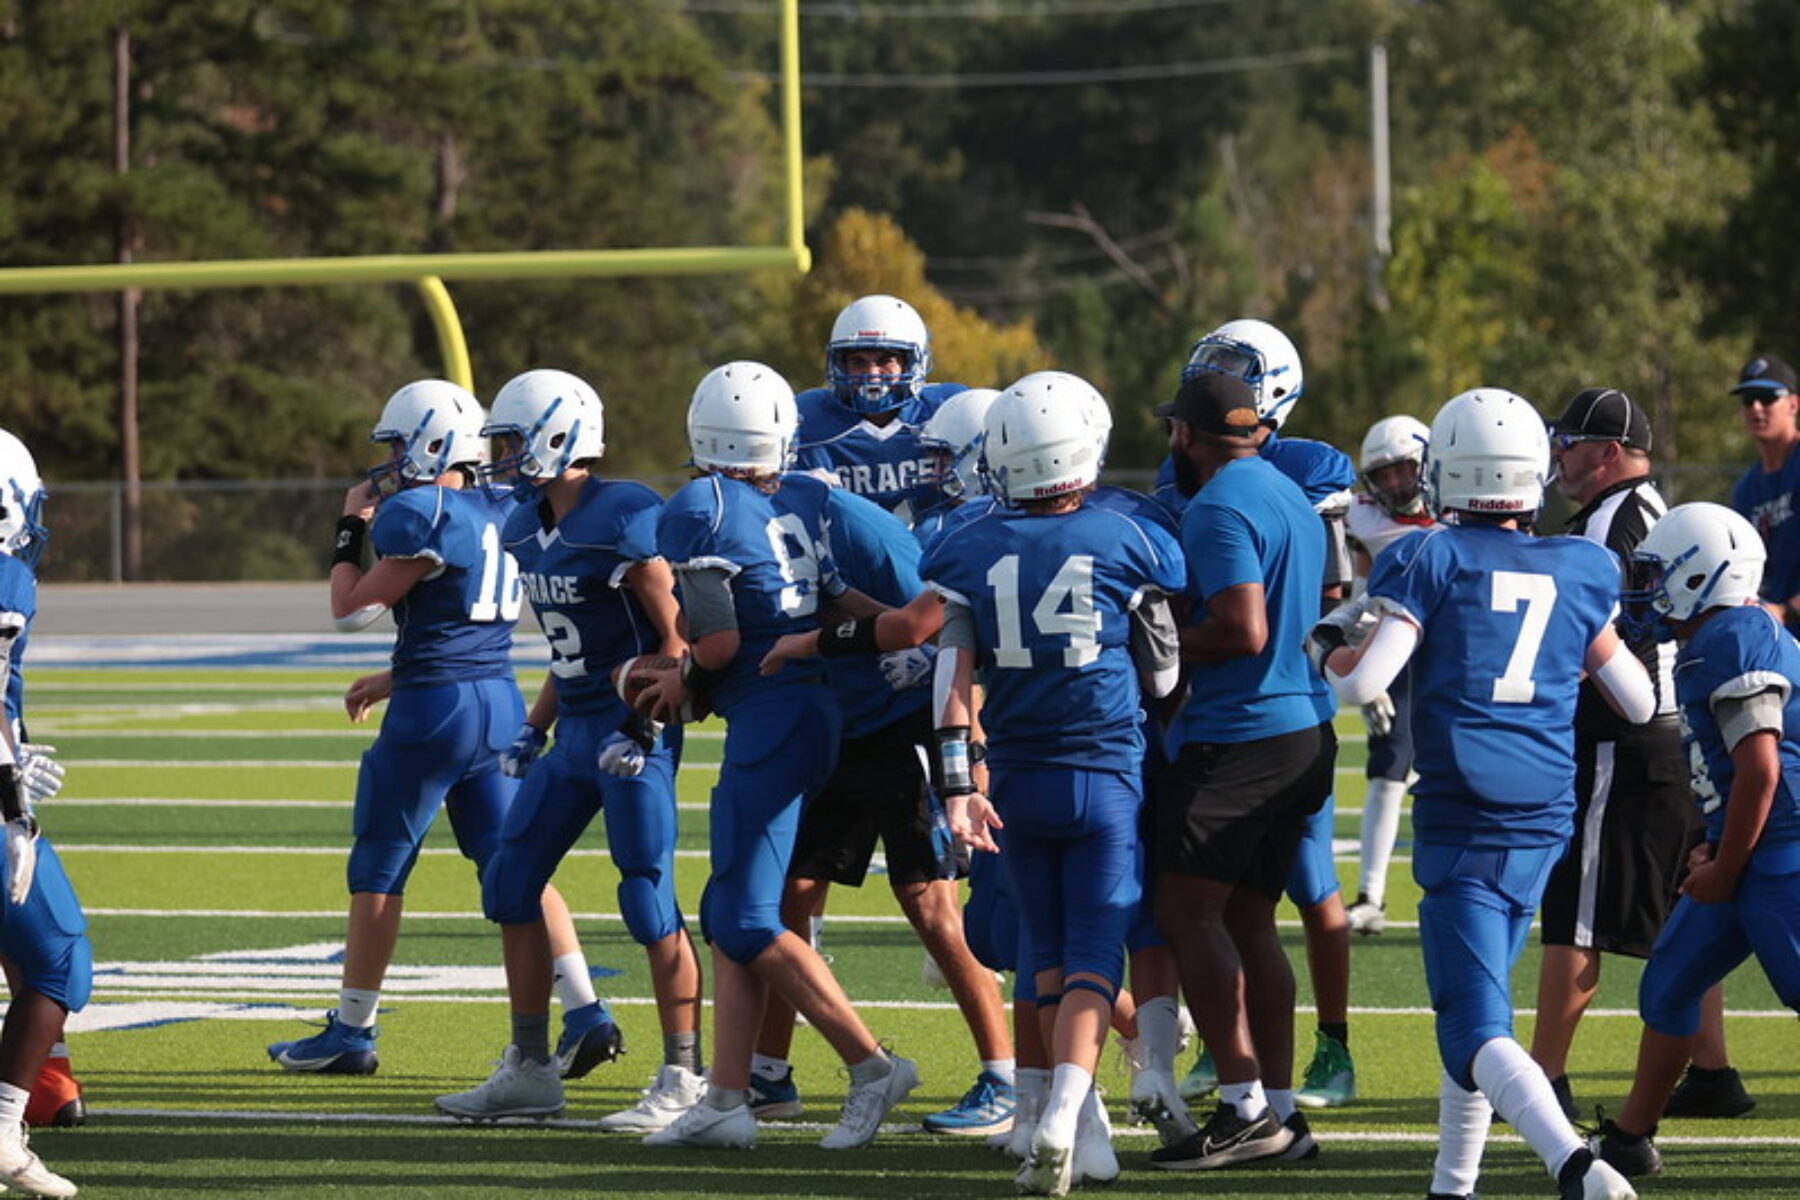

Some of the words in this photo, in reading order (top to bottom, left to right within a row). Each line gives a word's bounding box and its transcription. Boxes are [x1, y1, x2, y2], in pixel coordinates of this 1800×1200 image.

[836, 459, 940, 494] GRACE
[1034, 476, 1083, 496] Riddell
[1468, 498, 1524, 510] Riddell
[986, 554, 1103, 668] 14
[541, 611, 589, 679] 2
[1490, 570, 1558, 704] 7
